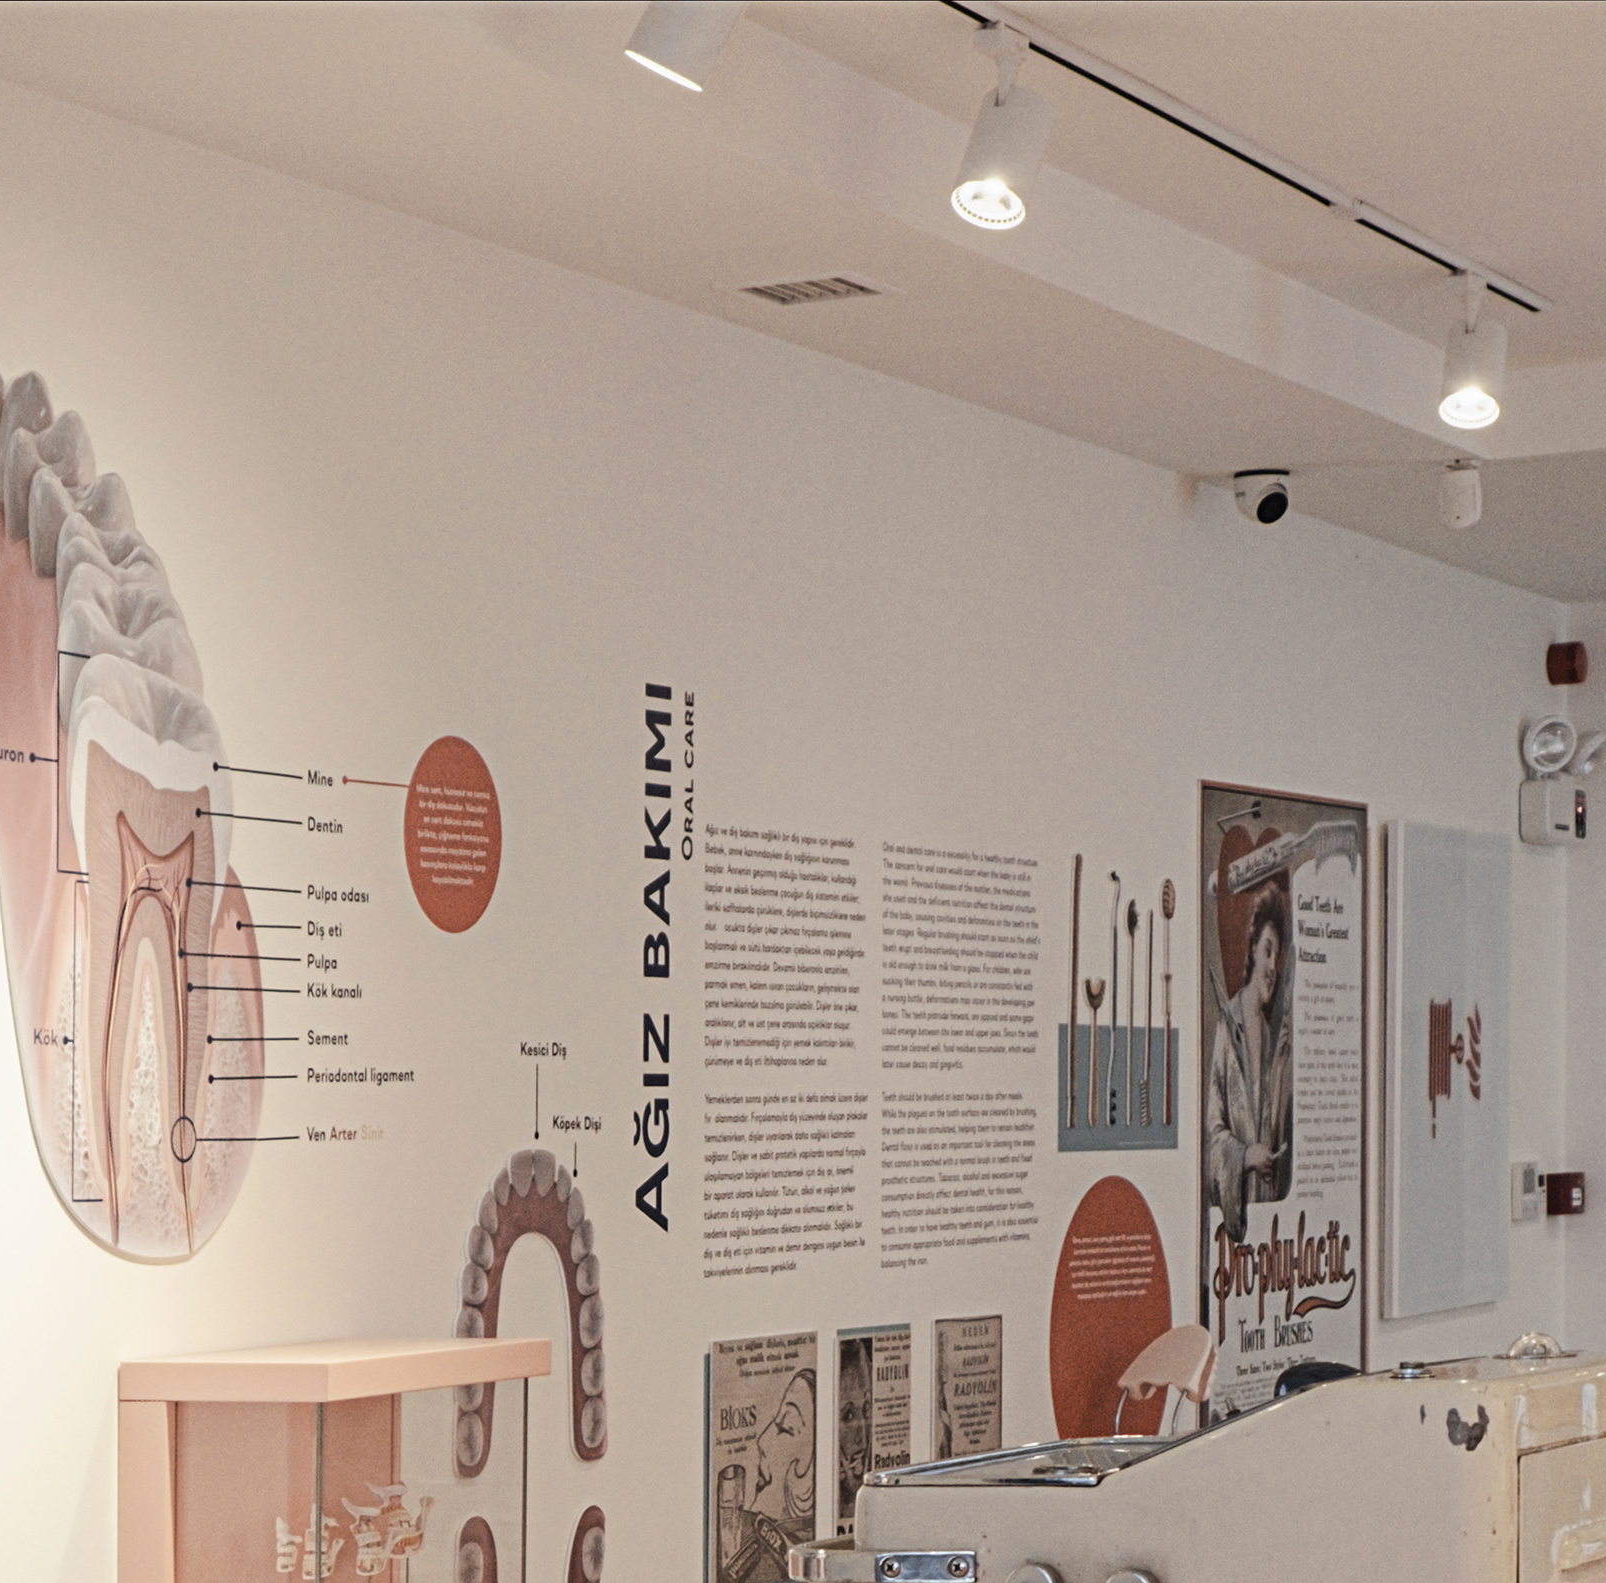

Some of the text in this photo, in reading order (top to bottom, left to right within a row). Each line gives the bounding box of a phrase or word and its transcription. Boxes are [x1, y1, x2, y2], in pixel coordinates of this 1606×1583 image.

[307, 769, 334, 787] Mine
[681, 691, 695, 860] ORAL CARE
[307, 815, 344, 834] Dentin
[307, 883, 370, 904] Pulpa odası
[306, 920, 343, 940] Diş eti
[306, 952, 338, 972] Pulpa
[633, 682, 673, 1232] AĞIZ BAKIMI
[306, 982, 363, 999] Kök kanalı
[33, 1026, 58, 1046] Kök
[306, 1029, 349, 1046] Sement
[520, 1041, 568, 1060] Kesici Diş
[306, 1067, 415, 1087] Periodontal ligament
[306, 1126, 327, 1142] Ven
[329, 1126, 358, 1141] Arter
[552, 1115, 602, 1134] Köpek Dişi
